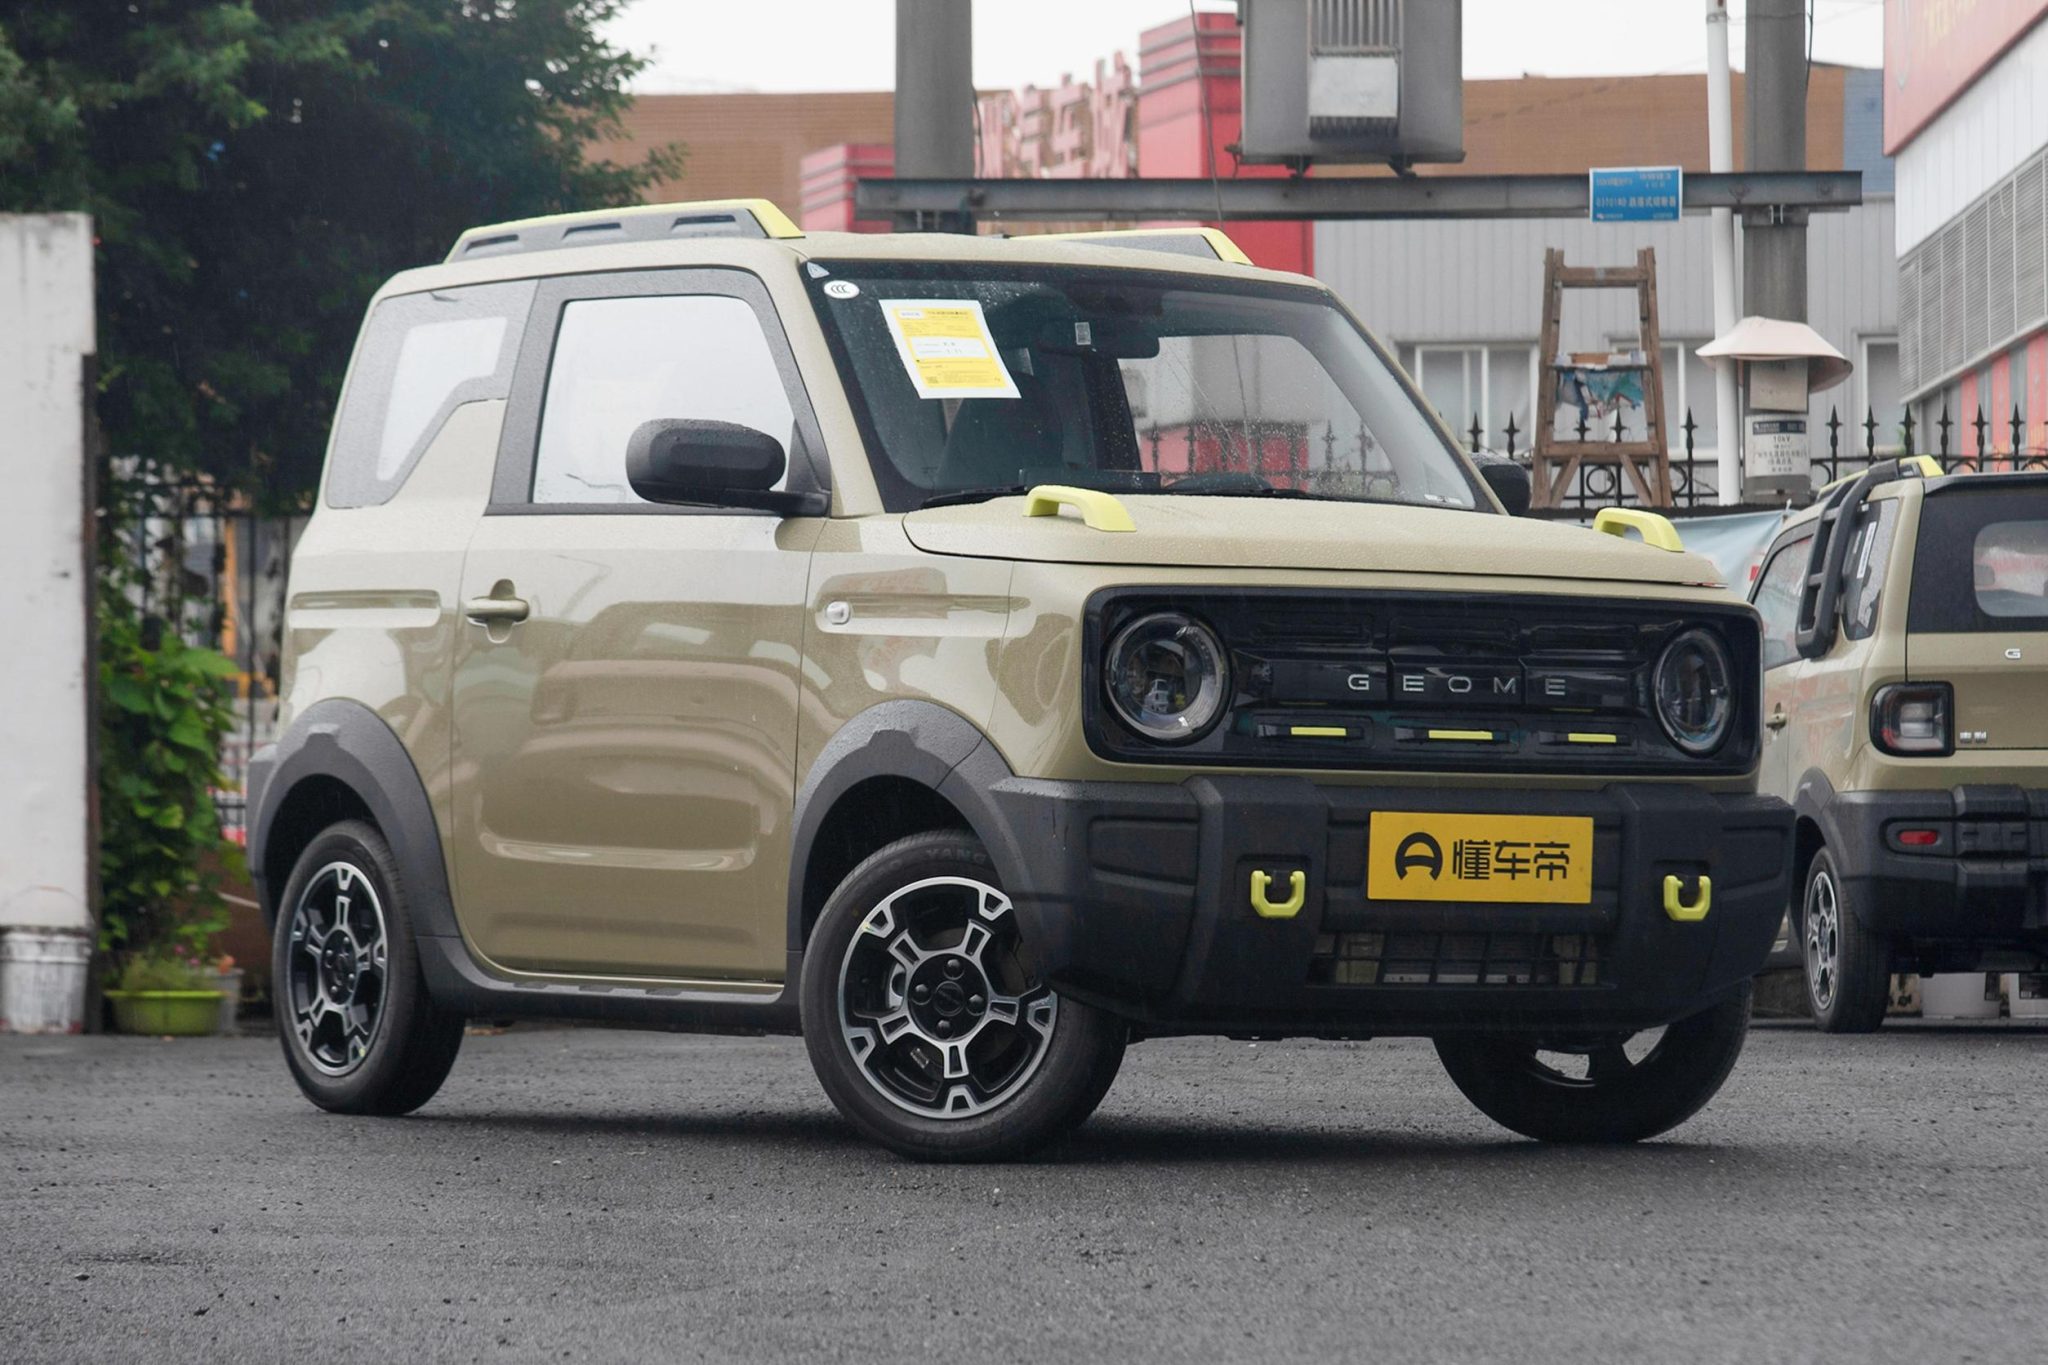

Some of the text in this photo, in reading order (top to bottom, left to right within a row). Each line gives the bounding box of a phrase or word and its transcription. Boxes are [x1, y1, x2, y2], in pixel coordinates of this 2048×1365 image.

[2005, 648, 2021, 659] G
[1347, 673, 1566, 696] GEOME
[1453, 839, 1571, 881] 懂车帝
